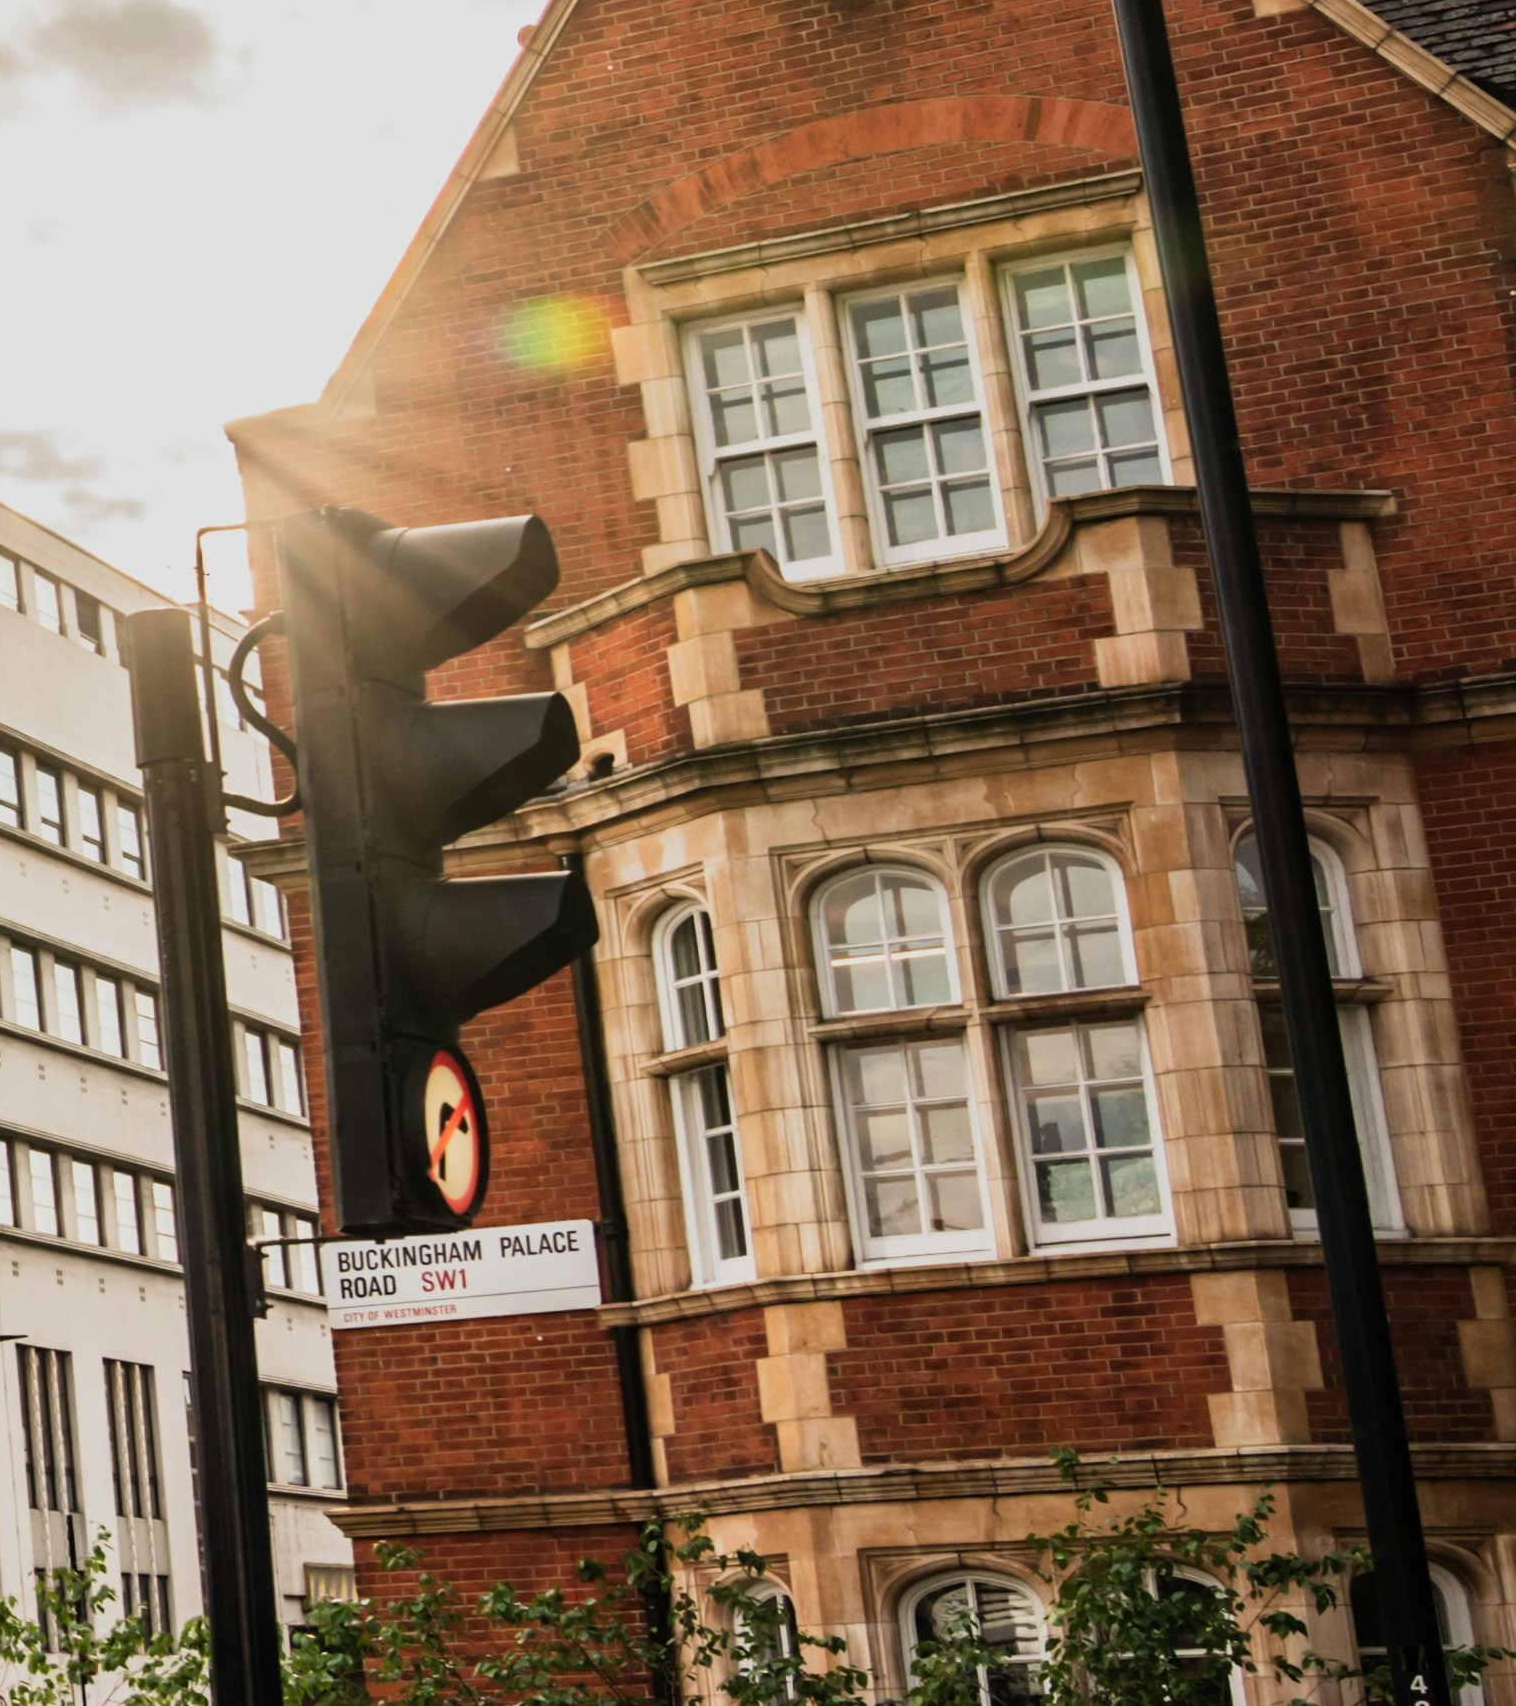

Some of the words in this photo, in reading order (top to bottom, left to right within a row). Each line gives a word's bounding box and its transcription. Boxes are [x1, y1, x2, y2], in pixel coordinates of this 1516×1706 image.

[337, 1239, 483, 1273] BUCKINGHAM
[499, 1230, 580, 1258] PALACE
[339, 1274, 397, 1299] ROAD
[421, 1268, 468, 1292] SW1
[343, 1312, 364, 1323] CITY
[367, 1311, 379, 1321] OF
[383, 1304, 457, 1320] WESTMINSTER
